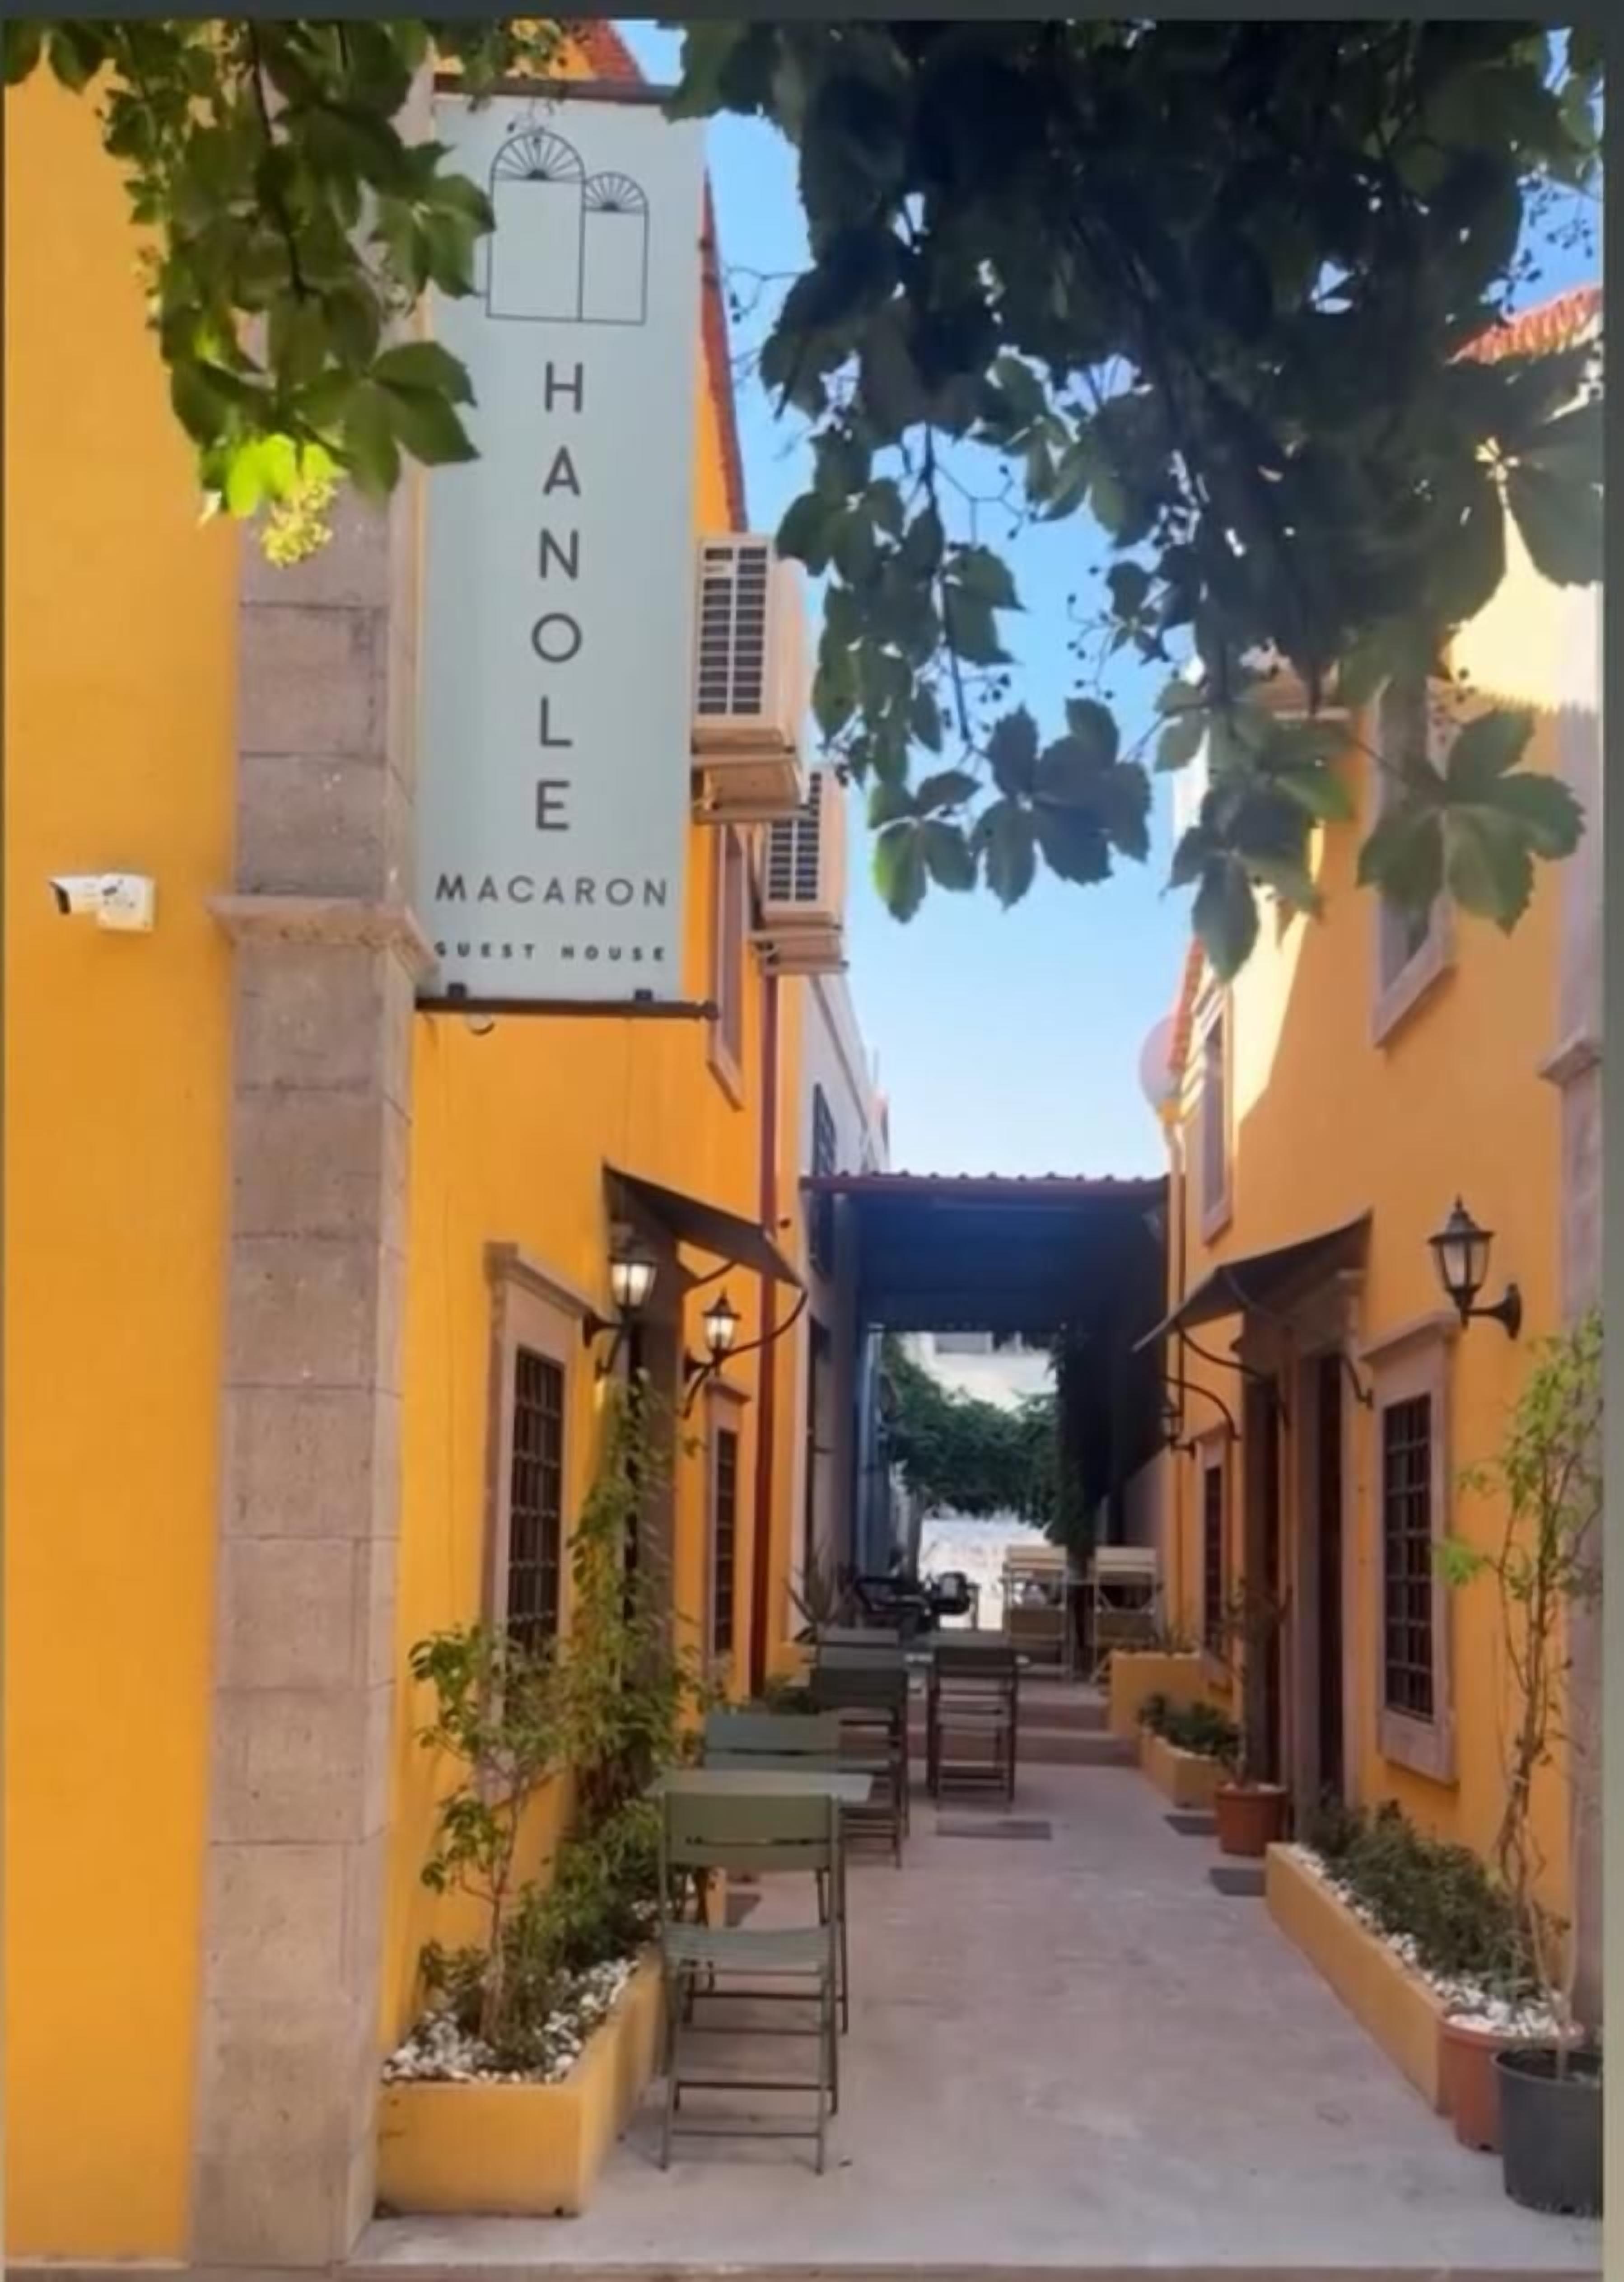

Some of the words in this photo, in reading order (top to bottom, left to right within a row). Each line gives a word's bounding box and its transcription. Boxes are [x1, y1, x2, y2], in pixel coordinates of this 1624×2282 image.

[531, 361, 584, 832] HANOLE
[436, 873, 667, 906] MACARON
[434, 940, 535, 959] GUEST
[561, 945, 665, 962] HOUSE
